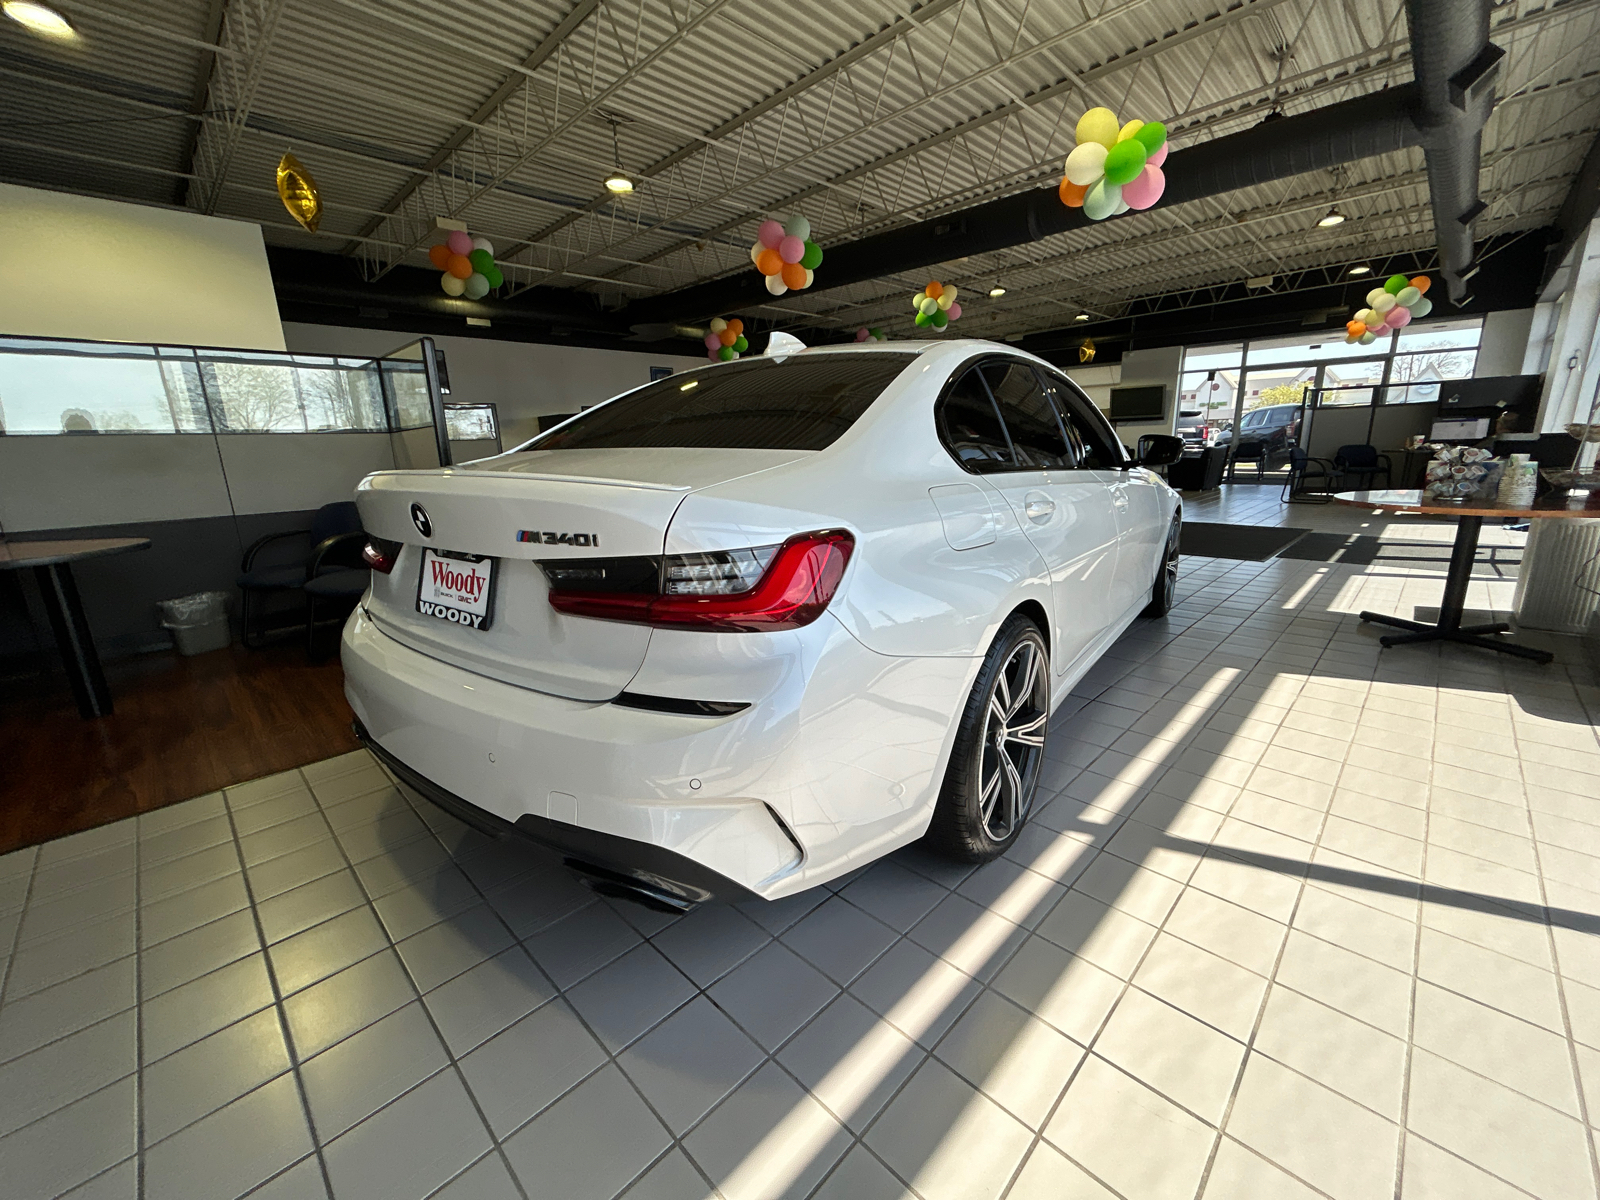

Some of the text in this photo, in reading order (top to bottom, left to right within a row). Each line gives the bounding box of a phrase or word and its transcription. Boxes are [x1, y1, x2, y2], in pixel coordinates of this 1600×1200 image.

[430, 560, 486, 603] Woody
[440, 591, 472, 605] BUICK GMC
[419, 600, 483, 629] WOODY
